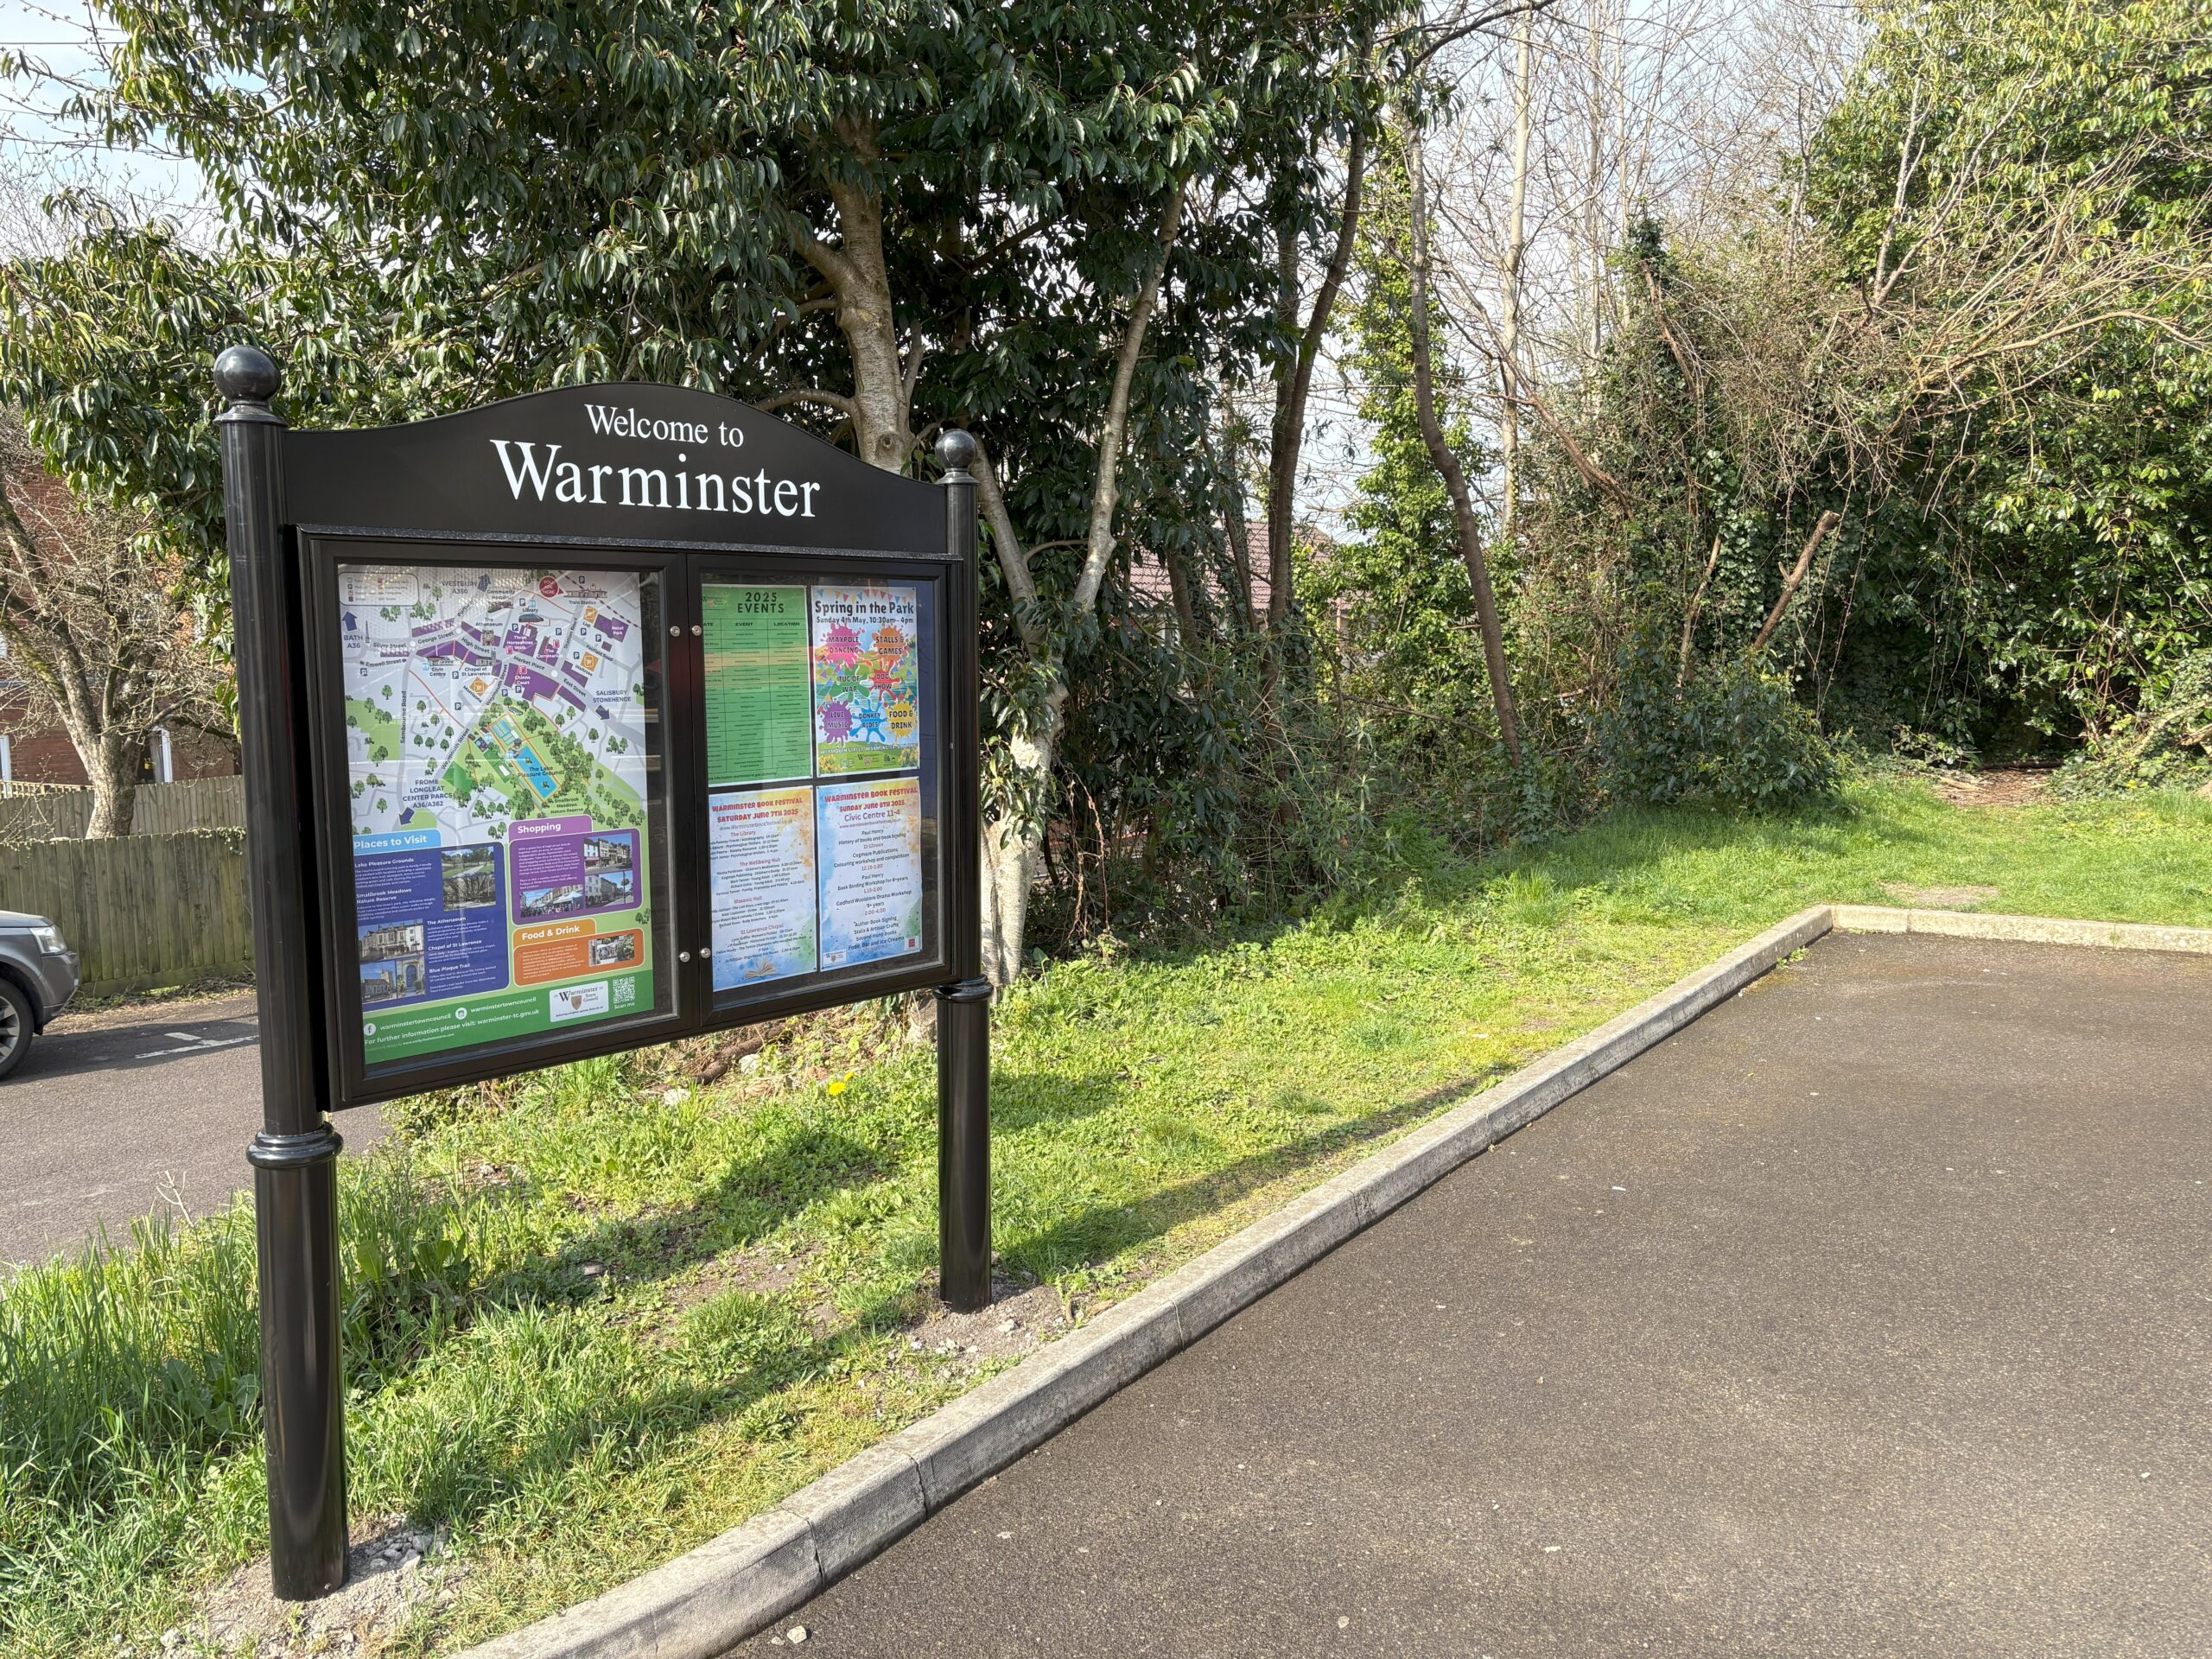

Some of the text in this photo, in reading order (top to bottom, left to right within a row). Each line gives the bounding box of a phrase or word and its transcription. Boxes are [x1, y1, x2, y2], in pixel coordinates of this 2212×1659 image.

[584, 404, 744, 447] Welcome to
[490, 439, 820, 518] Warminster
[746, 592, 777, 602] 2025
[738, 603, 784, 613] EVENTS
[815, 601, 913, 616] Spring in the Park
[437, 632, 454, 640] Street
[461, 637, 491, 654] High Street
[513, 656, 531, 665] Market
[575, 665, 593, 676] Waitrose
[463, 685, 482, 703] Morrisons
[563, 678, 586, 696] East Street
[458, 728, 470, 745] Street
[825, 792, 869, 802] WARMINSTER
[712, 803, 755, 812] WARMINSTER
[717, 814, 751, 823] SATURDAY
[518, 823, 561, 834] Shopping
[353, 840, 388, 849] Places
[404, 835, 427, 844] Visit
[522, 931, 544, 940] Food
[556, 925, 580, 935] Drink
[558, 986, 599, 1002] Warminster
[471, 997, 537, 1013] warminstertowncouncil
[377, 1033, 400, 1044] further
[401, 1028, 439, 1039] information
[441, 1024, 461, 1033] please
[477, 1009, 539, 1025] warminster-tc.gov.uk
[380, 1013, 451, 1031] warminstertowncouncil
